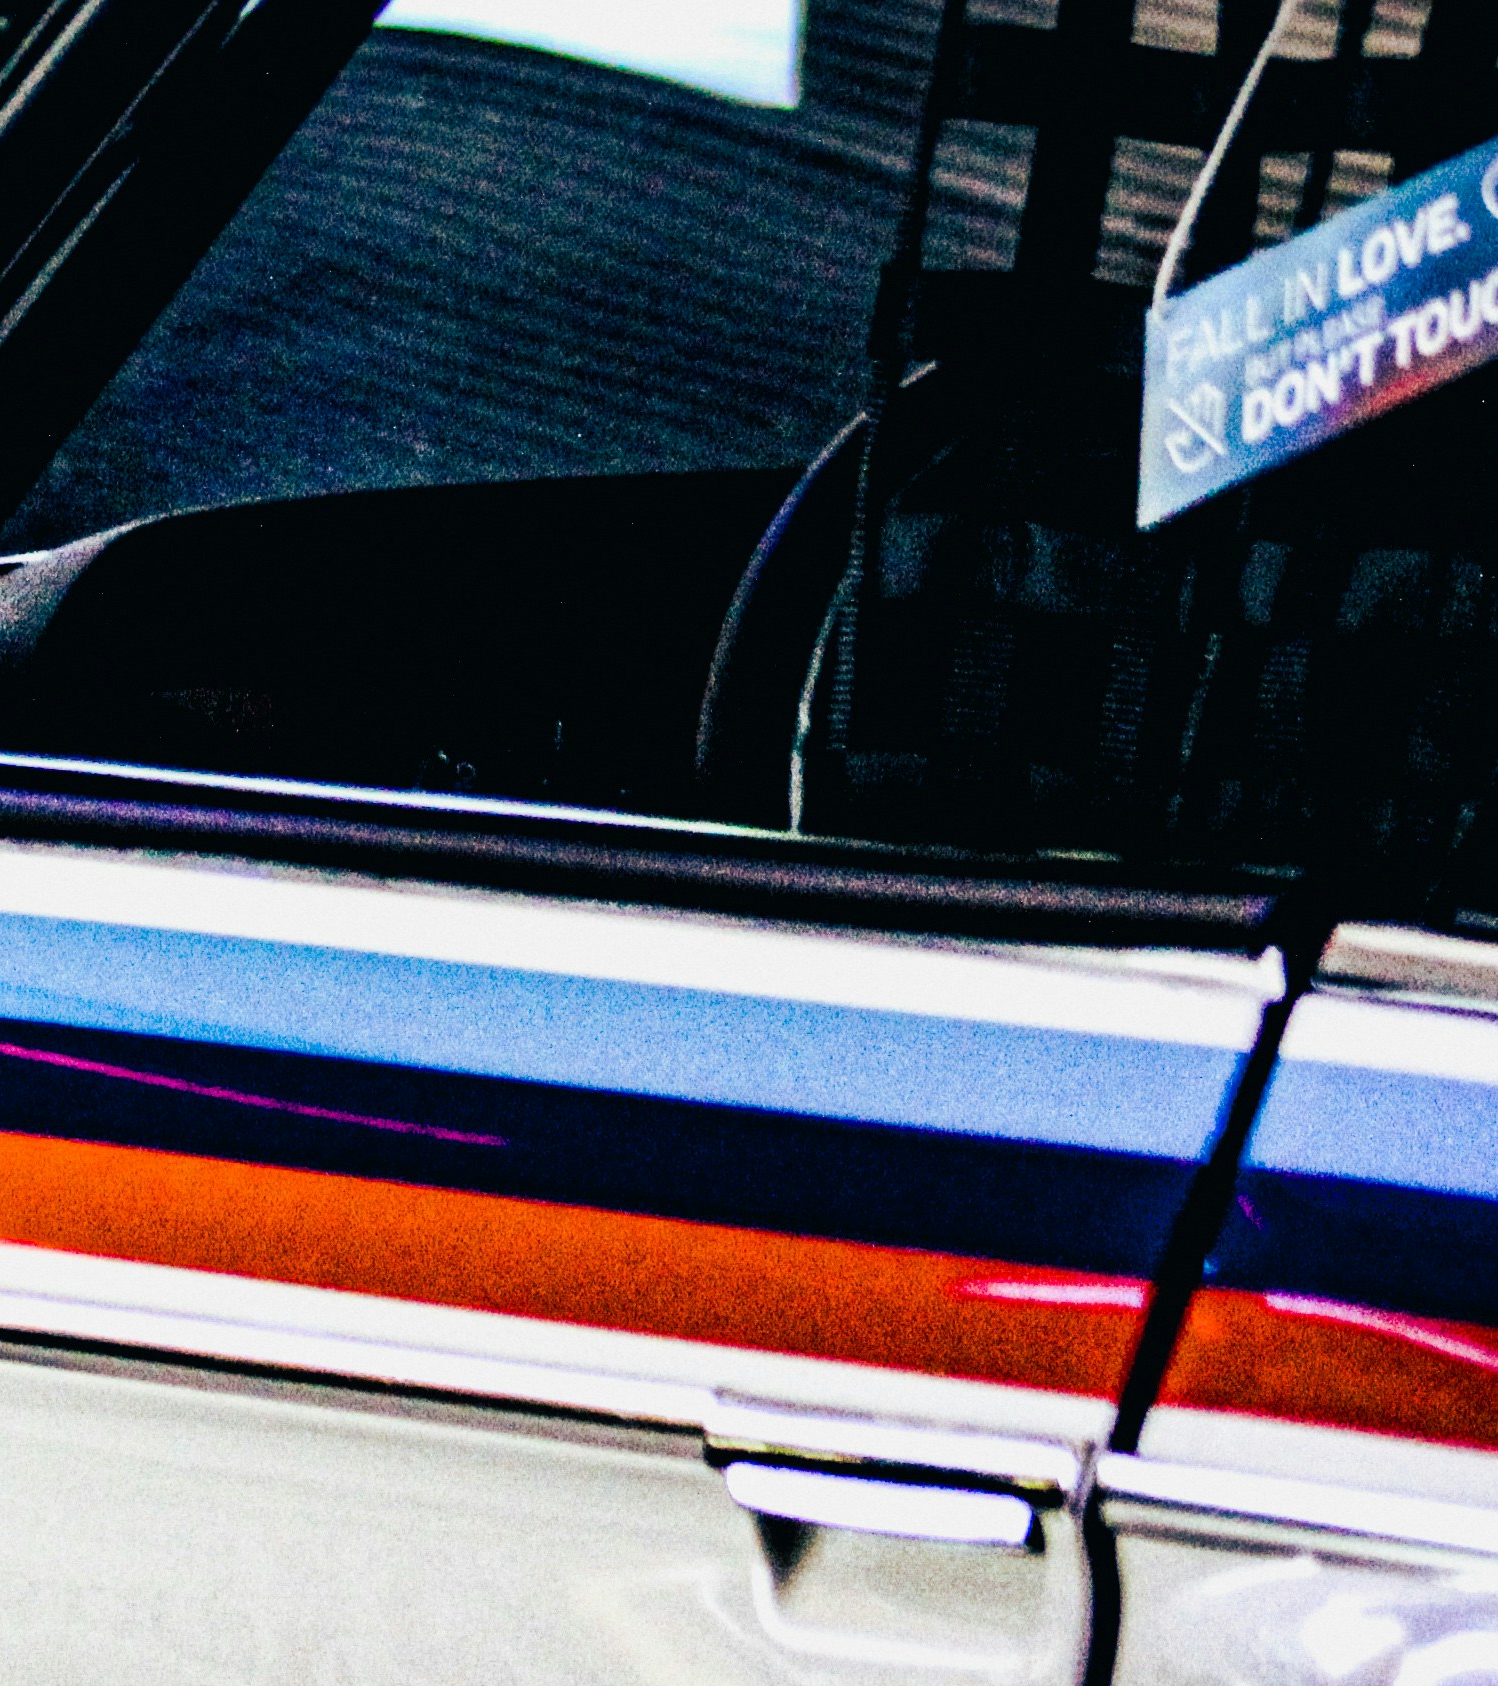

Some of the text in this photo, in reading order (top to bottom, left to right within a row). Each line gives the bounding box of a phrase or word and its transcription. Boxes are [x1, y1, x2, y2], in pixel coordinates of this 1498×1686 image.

[1283, 262, 1329, 325] IN
[1337, 193, 1471, 298] LOVE.
[1241, 330, 1385, 444] DON'T
